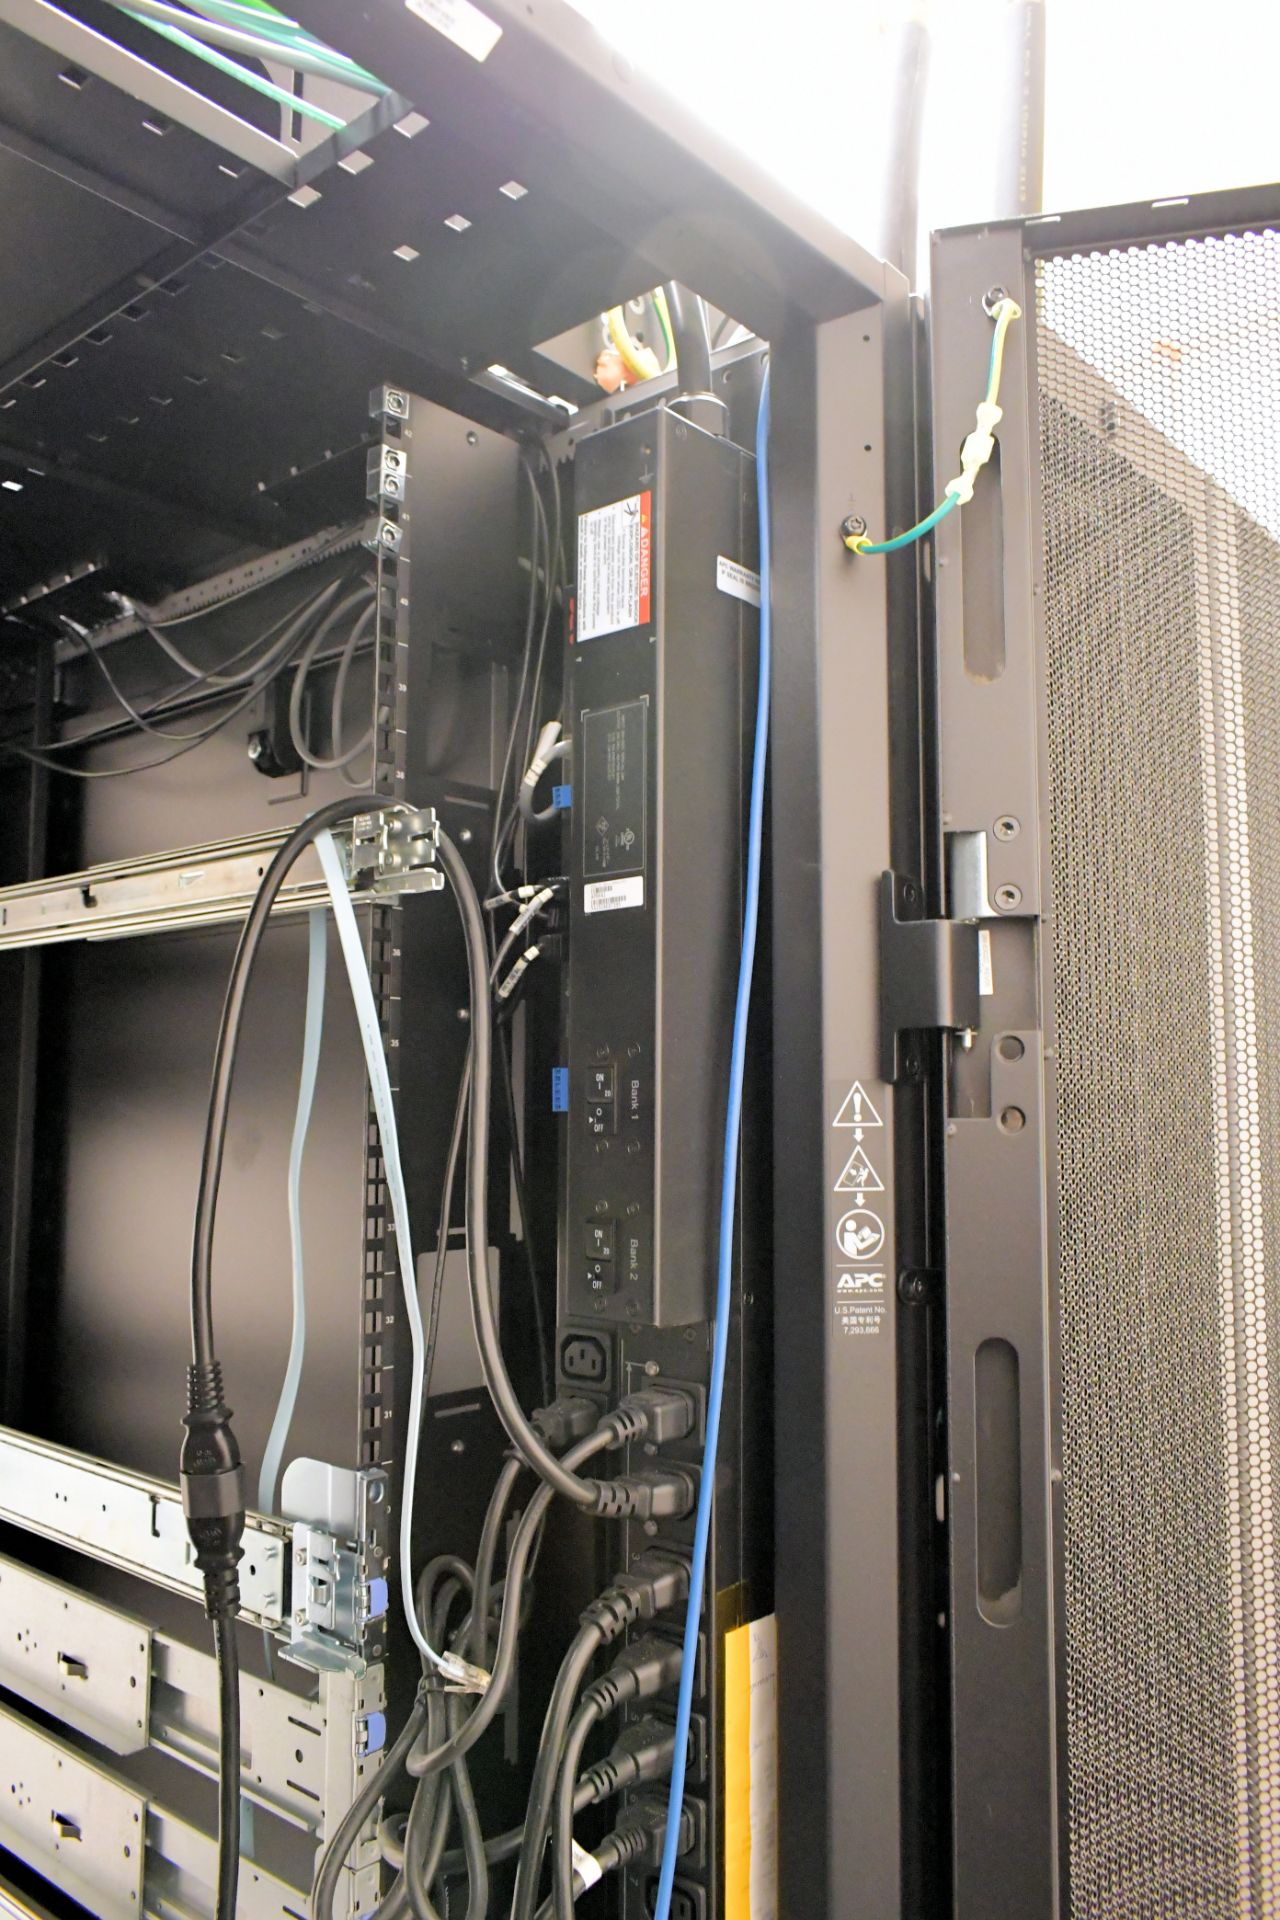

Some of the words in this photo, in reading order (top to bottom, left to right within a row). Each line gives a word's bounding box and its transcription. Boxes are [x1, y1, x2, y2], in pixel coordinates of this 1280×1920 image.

[640, 538, 649, 597] DANGER
[595, 1073, 604, 1082] ON
[631, 1080, 639, 1110] Bank
[593, 1123, 604, 1132] OFF
[594, 1229, 603, 1238] ON
[630, 1238, 639, 1269] Bank
[629, 1272, 638, 1281] 2
[836, 1272, 884, 1288] APC
[592, 1280, 602, 1289] OFF
[874, 1305, 888, 1314] No.
[385, 1315, 395, 1324] 32
[383, 1410, 392, 1419] 31
[631, 1552, 641, 1561] 3
